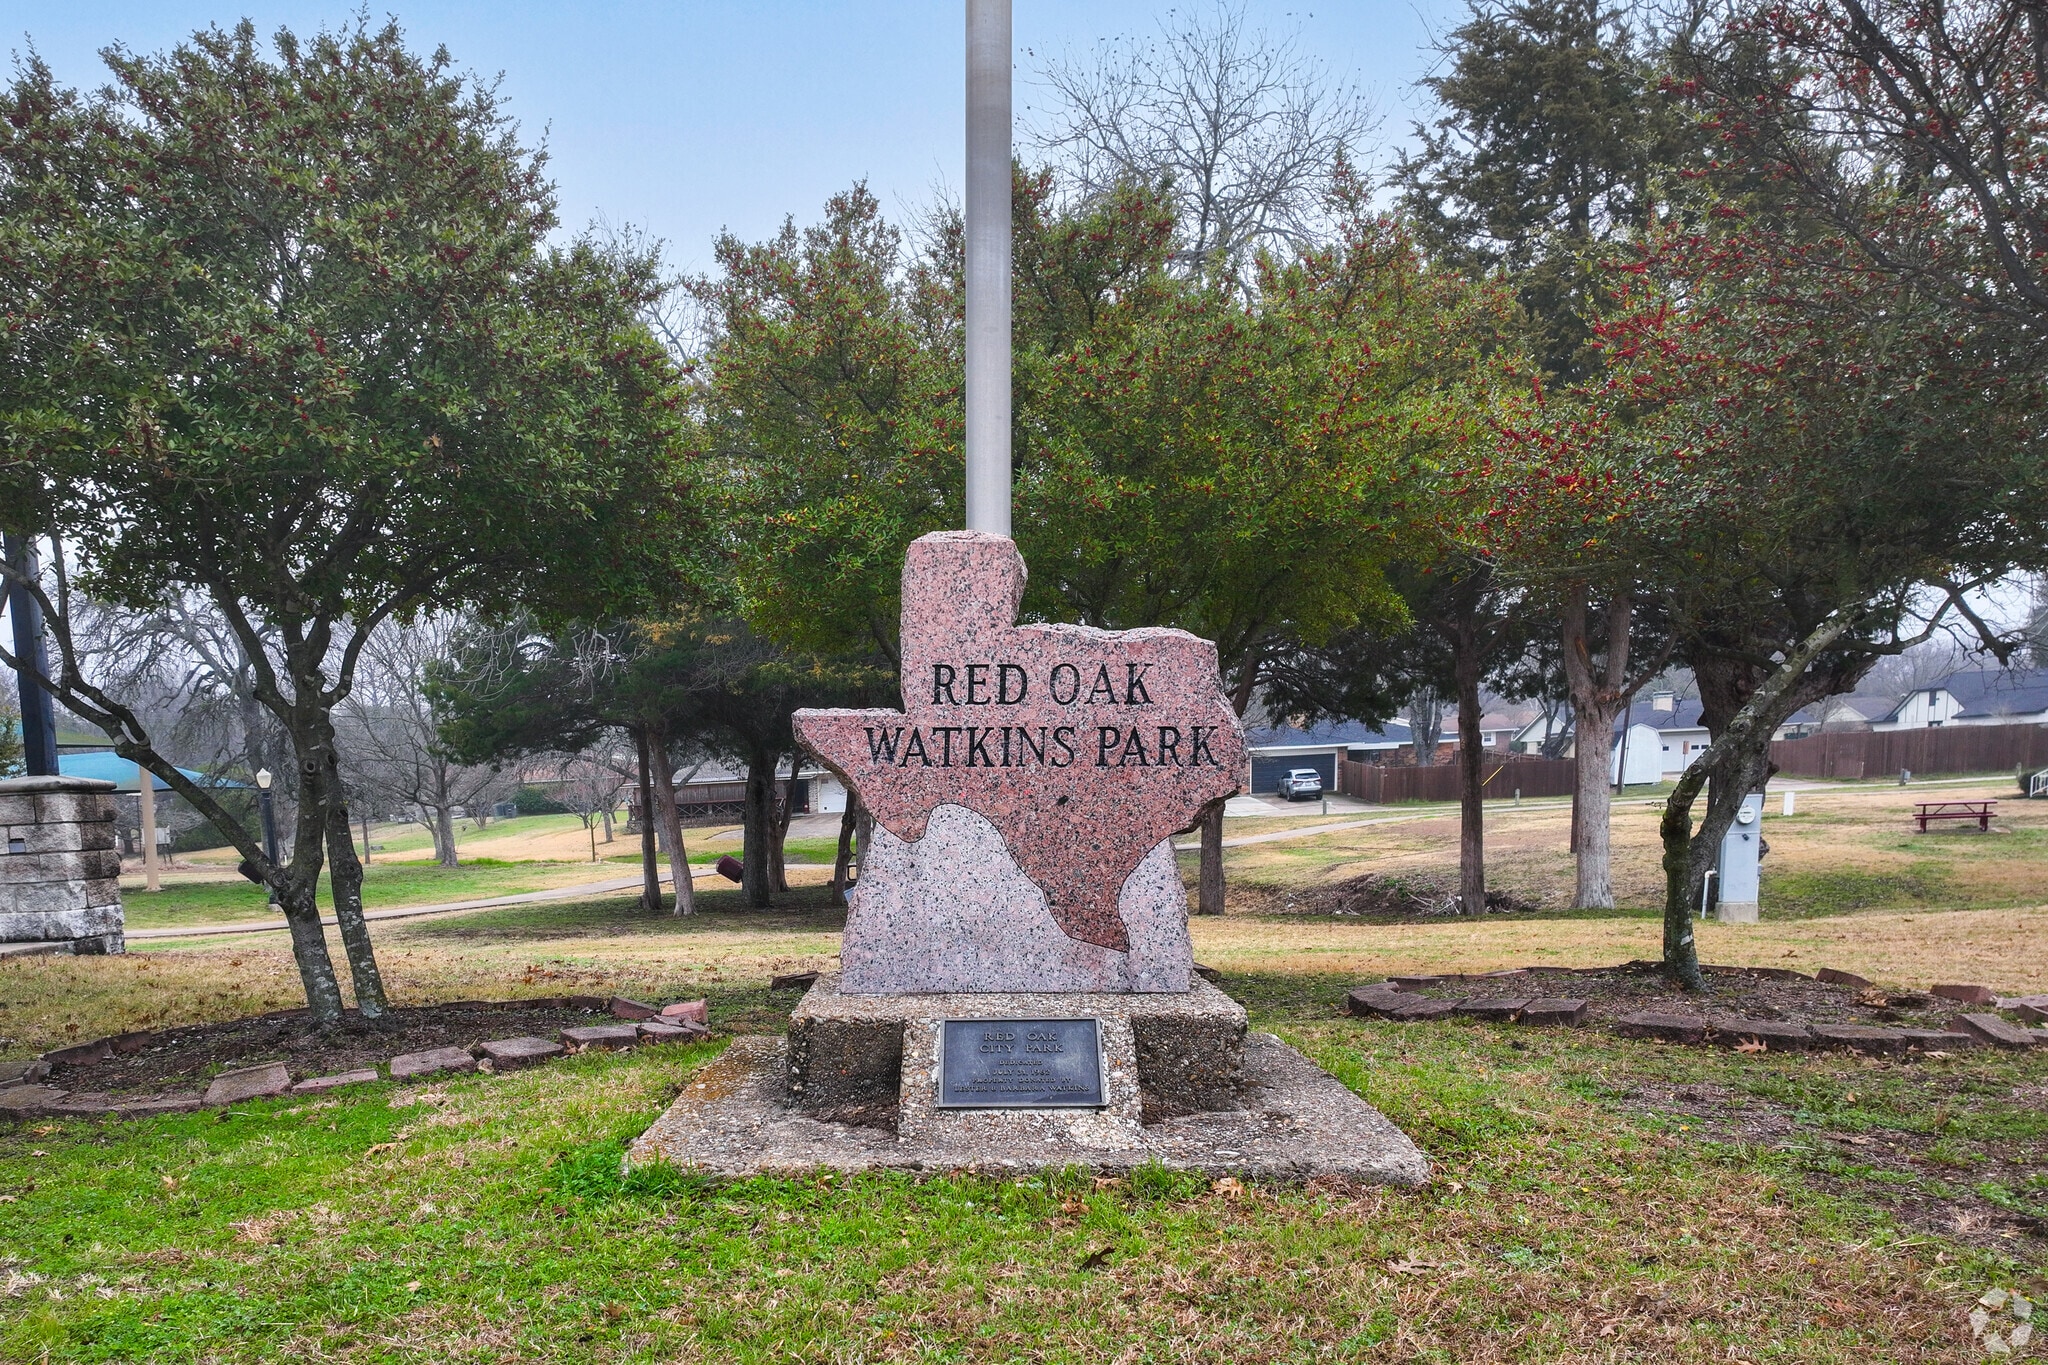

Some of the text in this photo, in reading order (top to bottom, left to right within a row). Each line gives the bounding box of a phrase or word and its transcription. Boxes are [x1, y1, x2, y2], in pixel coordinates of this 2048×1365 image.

[932, 663, 1154, 706] RED OAK
[864, 725, 1219, 768] WATKINS PARK
[984, 1032, 1058, 1042] RED OAK
[979, 1043, 1064, 1054] CITY PARK
[998, 1059, 1044, 1067] DEDICATED
[992, 1069, 1014, 1077] JULY
[954, 1085, 988, 1093] LESTER
[1000, 1085, 1046, 1093] BARBARA
[1048, 1085, 1090, 1093] WATKINS
